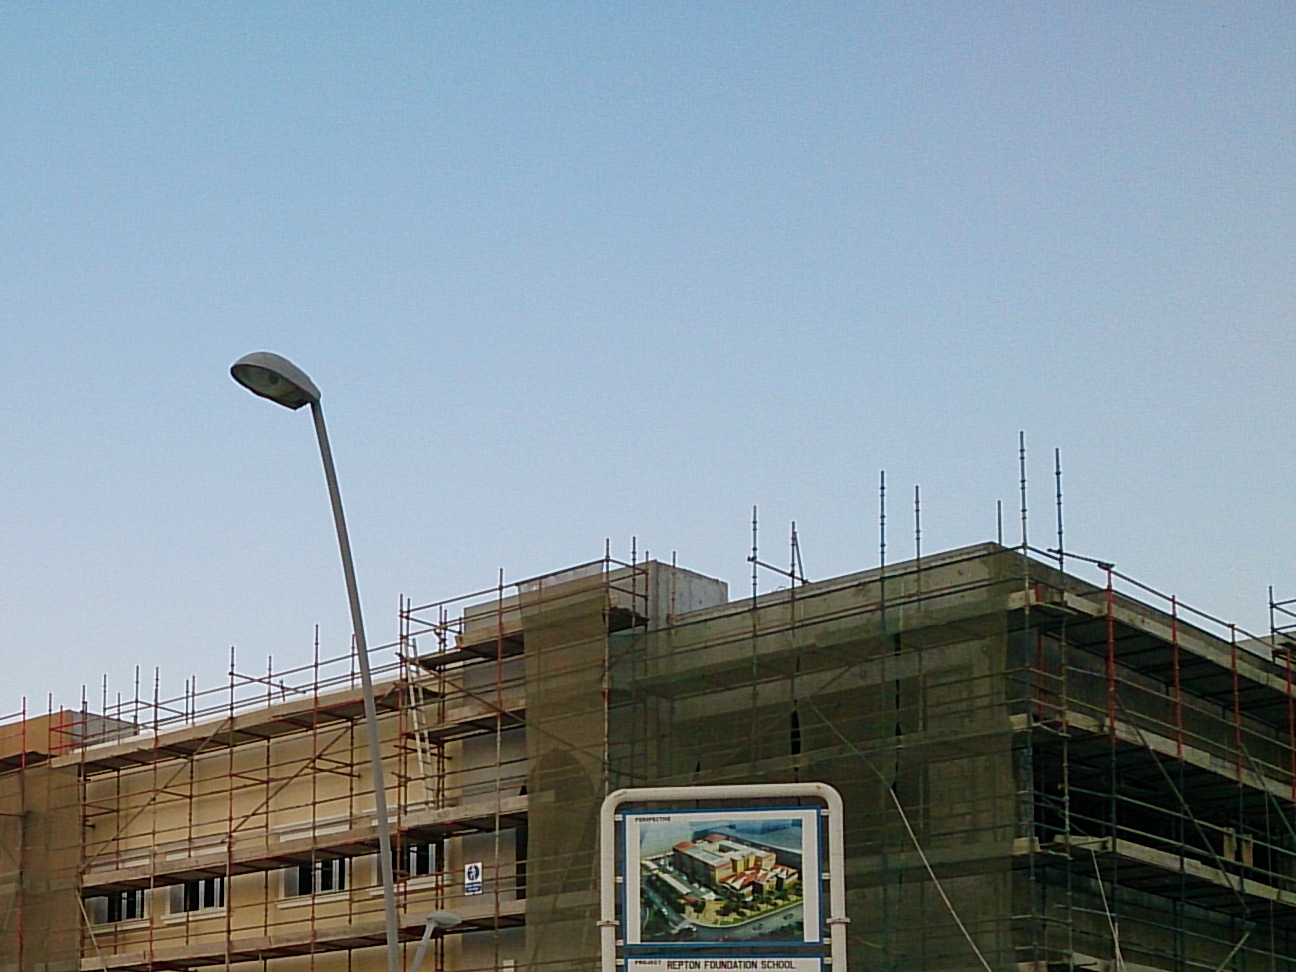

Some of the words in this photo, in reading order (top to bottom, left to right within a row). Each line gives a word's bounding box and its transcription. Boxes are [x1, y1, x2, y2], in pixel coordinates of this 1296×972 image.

[667, 960, 701, 970] REPTON
[704, 960, 758, 970] FOUNDATION
[761, 960, 796, 970] SCHOOL
